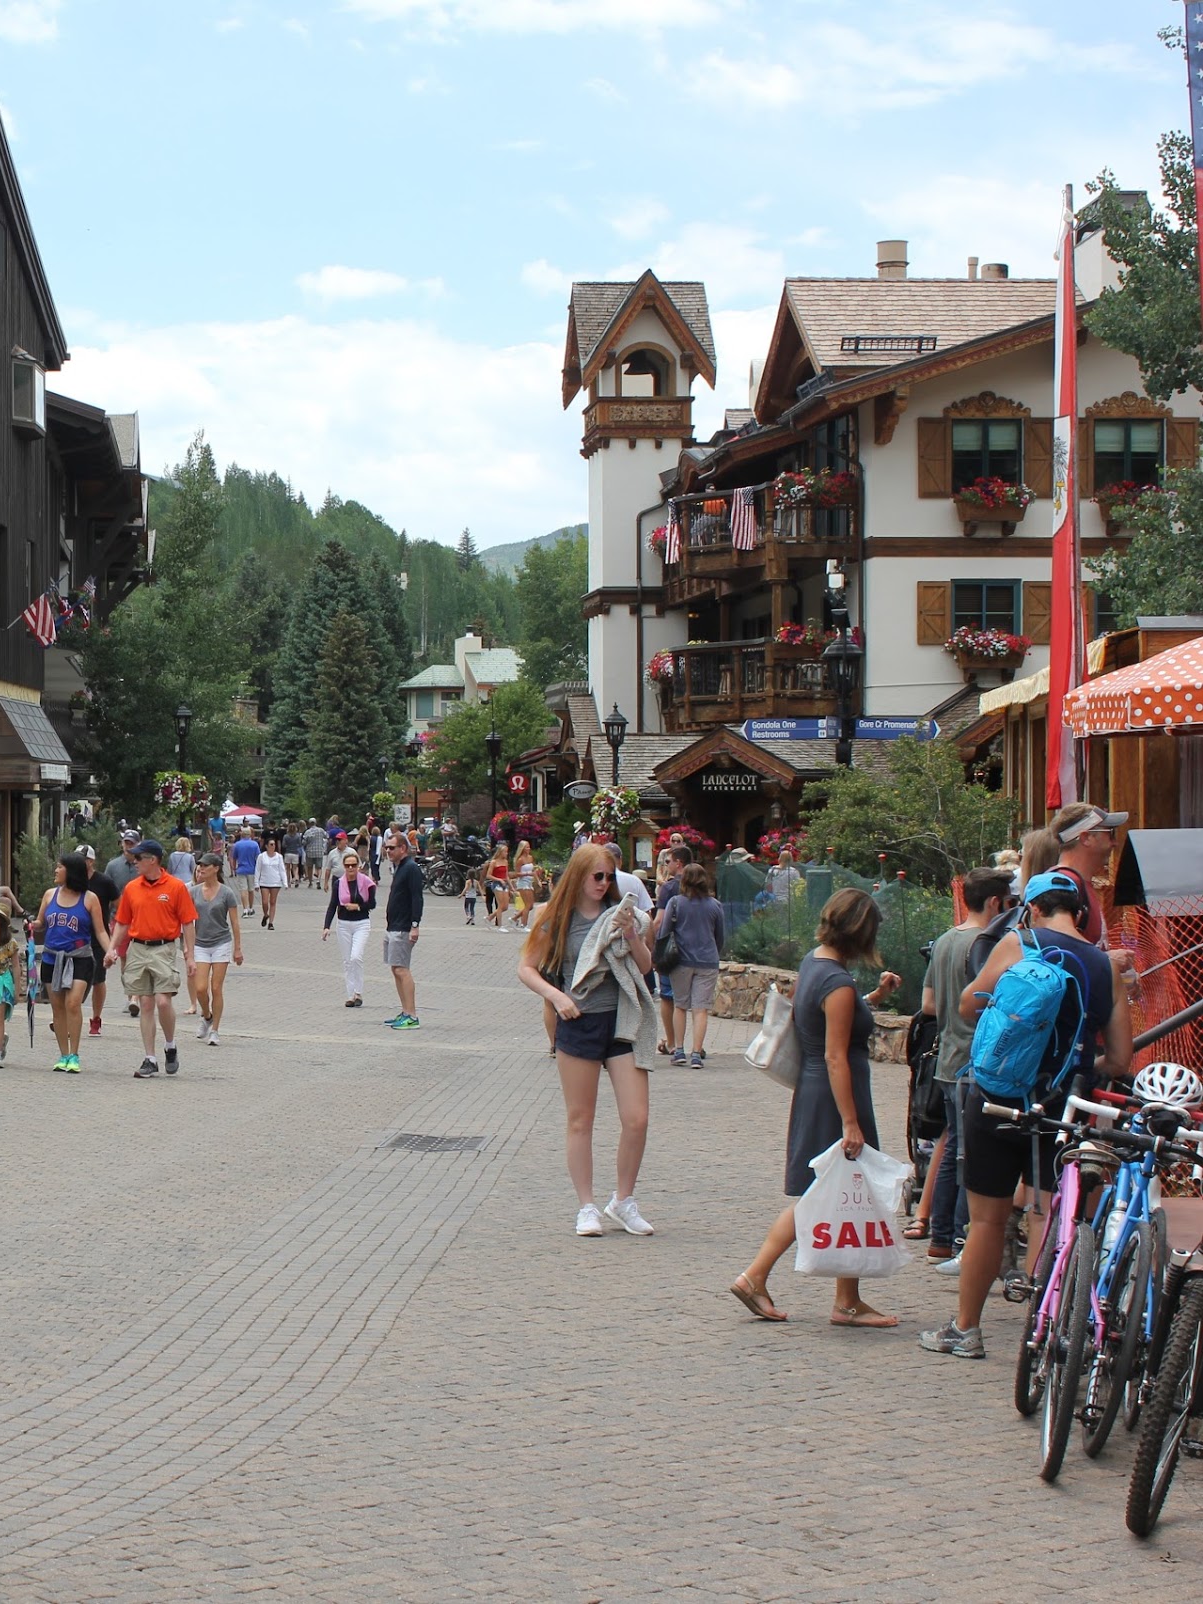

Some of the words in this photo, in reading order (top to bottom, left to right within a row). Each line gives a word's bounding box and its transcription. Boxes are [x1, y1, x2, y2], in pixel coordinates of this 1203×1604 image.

[751, 720, 781, 729] Gondola
[782, 720, 796, 729] One
[859, 720, 874, 728] Gore
[875, 720, 883, 728] Cr
[884, 720, 919, 729] Promenad
[751, 730, 790, 738] Restrooms
[702, 774, 757, 785] LANCELOT
[47, 912, 78, 932] USA
